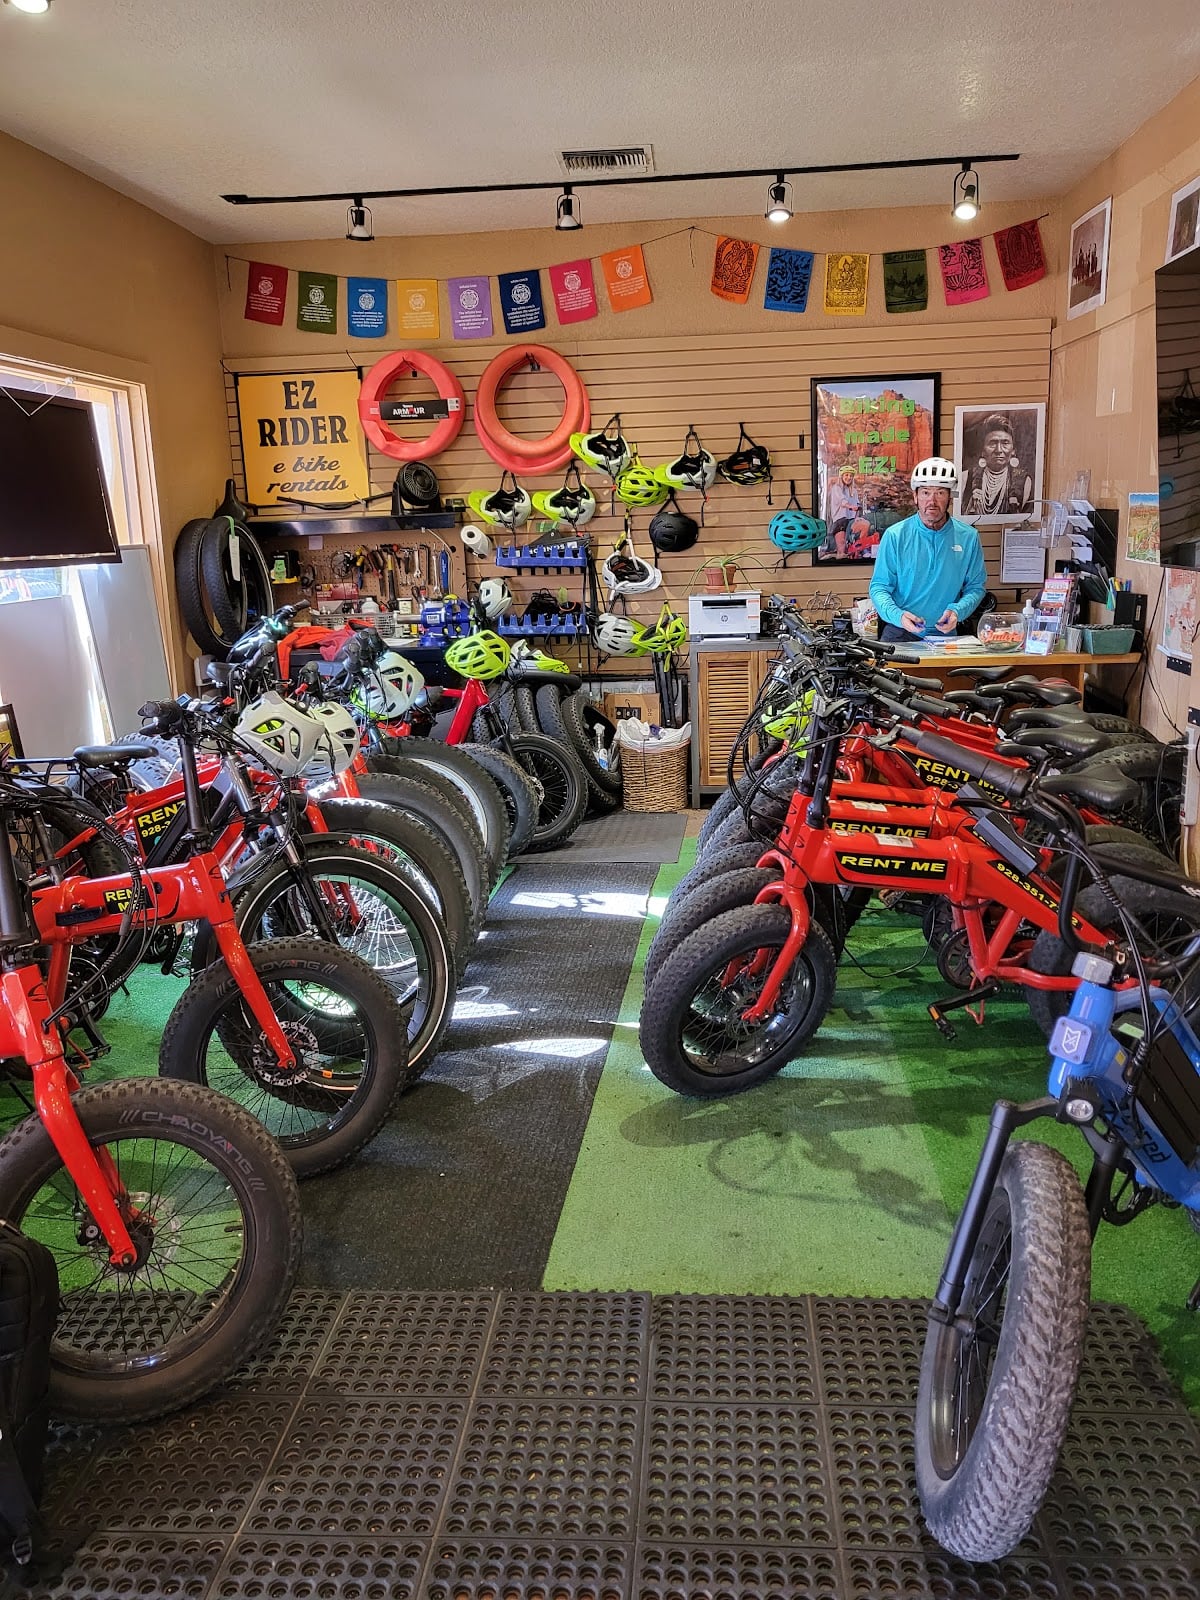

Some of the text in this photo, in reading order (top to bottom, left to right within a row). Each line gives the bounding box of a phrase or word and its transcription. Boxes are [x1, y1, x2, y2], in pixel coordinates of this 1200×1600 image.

[282, 380, 317, 410] EZ
[839, 396, 915, 417] Biking
[257, 415, 350, 447] RIDER
[845, 426, 911, 445] made
[273, 456, 341, 473] e bike
[858, 455, 897, 475] EZ!
[266, 474, 349, 494] rentals
[915, 757, 971, 783] RENT
[831, 822, 928, 838] RENT ME
[840, 855, 946, 873] RENT ME
[105, 887, 139, 903] REN
[996, 862, 1079, 927] 928-351-72
[141, 1110, 255, 1176] CHAOYANG
